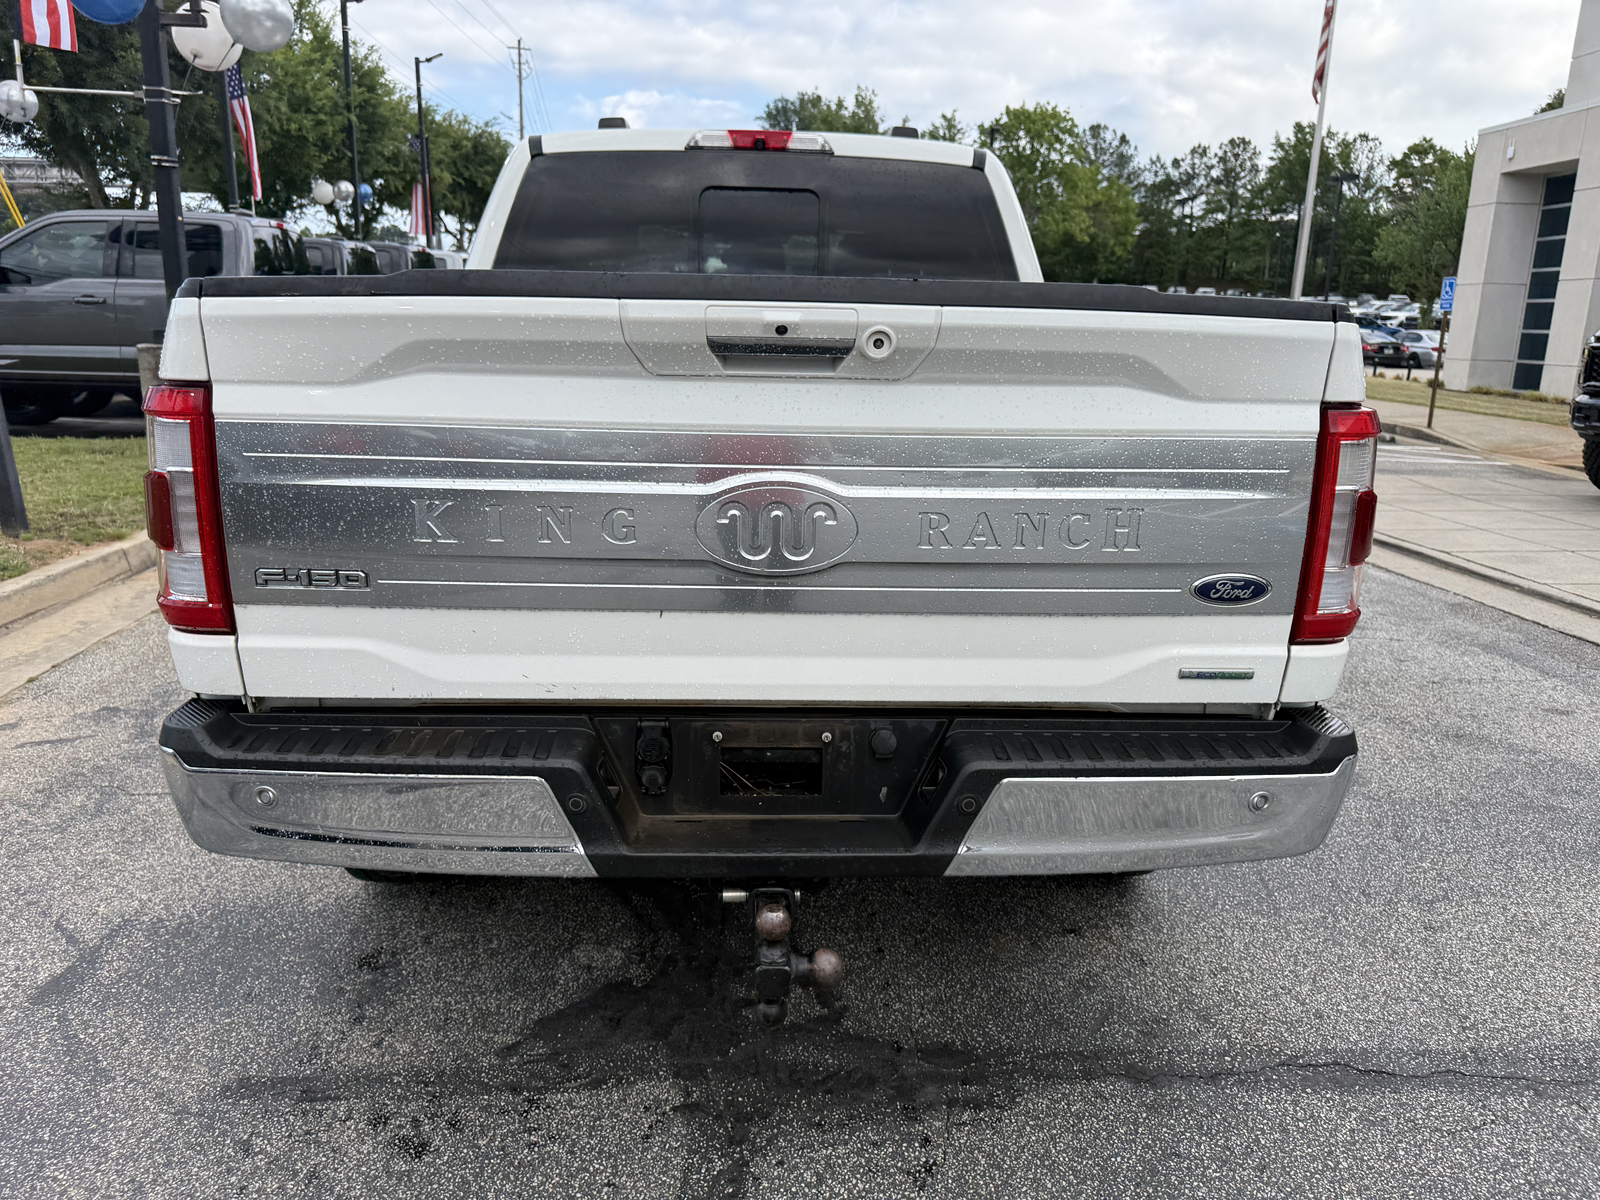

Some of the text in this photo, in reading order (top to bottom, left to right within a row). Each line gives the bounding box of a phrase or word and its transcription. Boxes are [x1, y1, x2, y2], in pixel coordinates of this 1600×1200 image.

[410, 498, 1145, 552] KING RANCH
[254, 567, 371, 591] F-150
[1210, 580, 1255, 599] Ford
